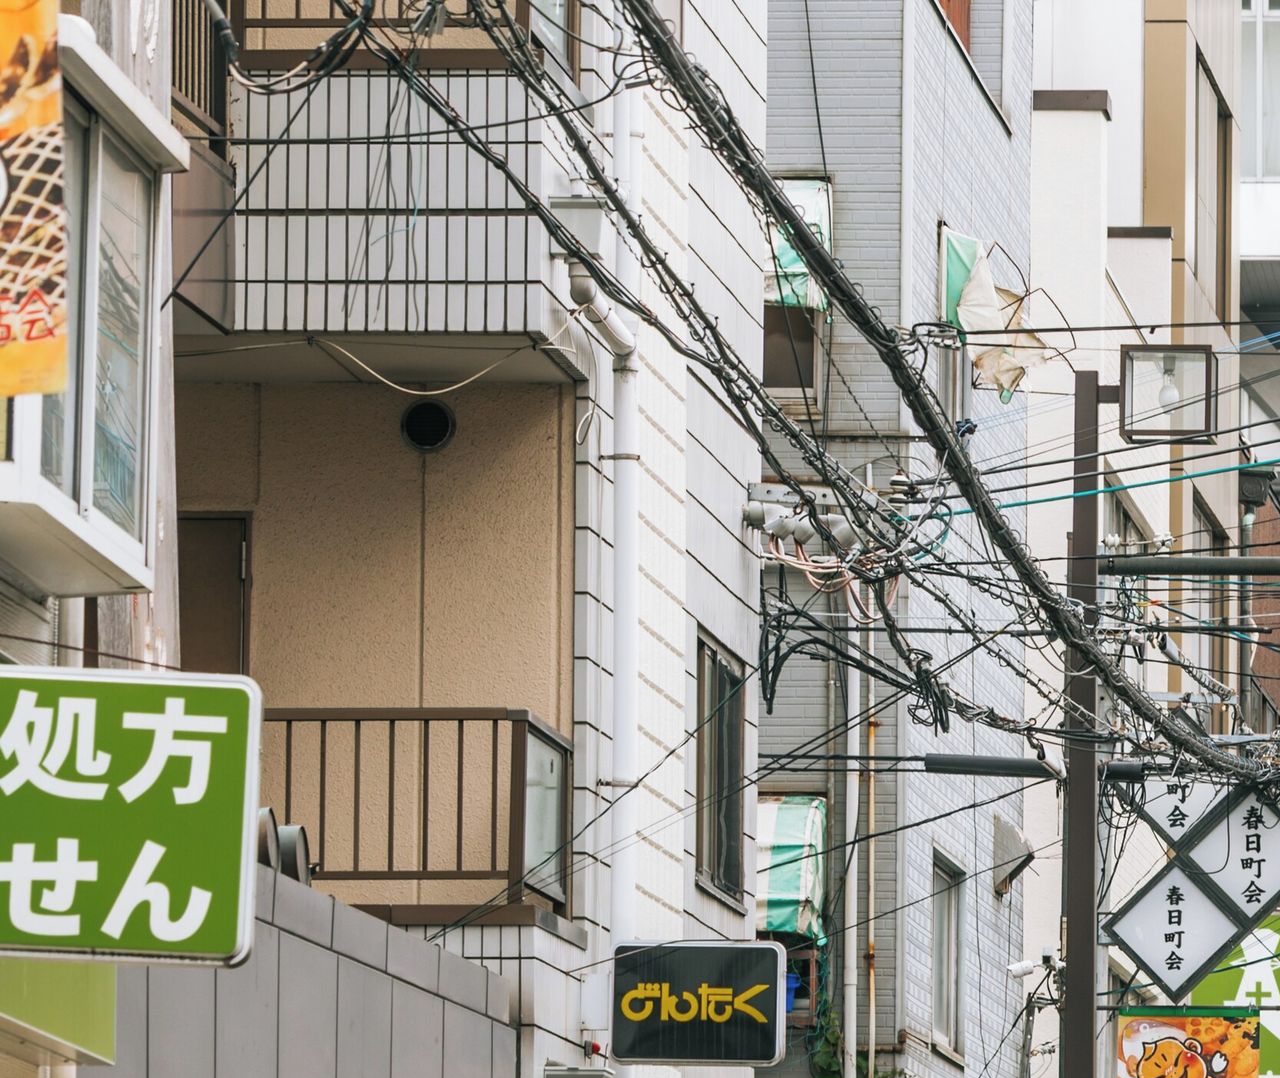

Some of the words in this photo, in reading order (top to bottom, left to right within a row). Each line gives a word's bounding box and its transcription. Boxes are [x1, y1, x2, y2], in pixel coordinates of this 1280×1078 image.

[0, 690, 228, 804] 処方
[1166, 783, 1190, 828] 町会
[1240, 805, 1266, 904] 春日町会
[3, 838, 212, 942] せん
[1164, 885, 1186, 971] 春日町会
